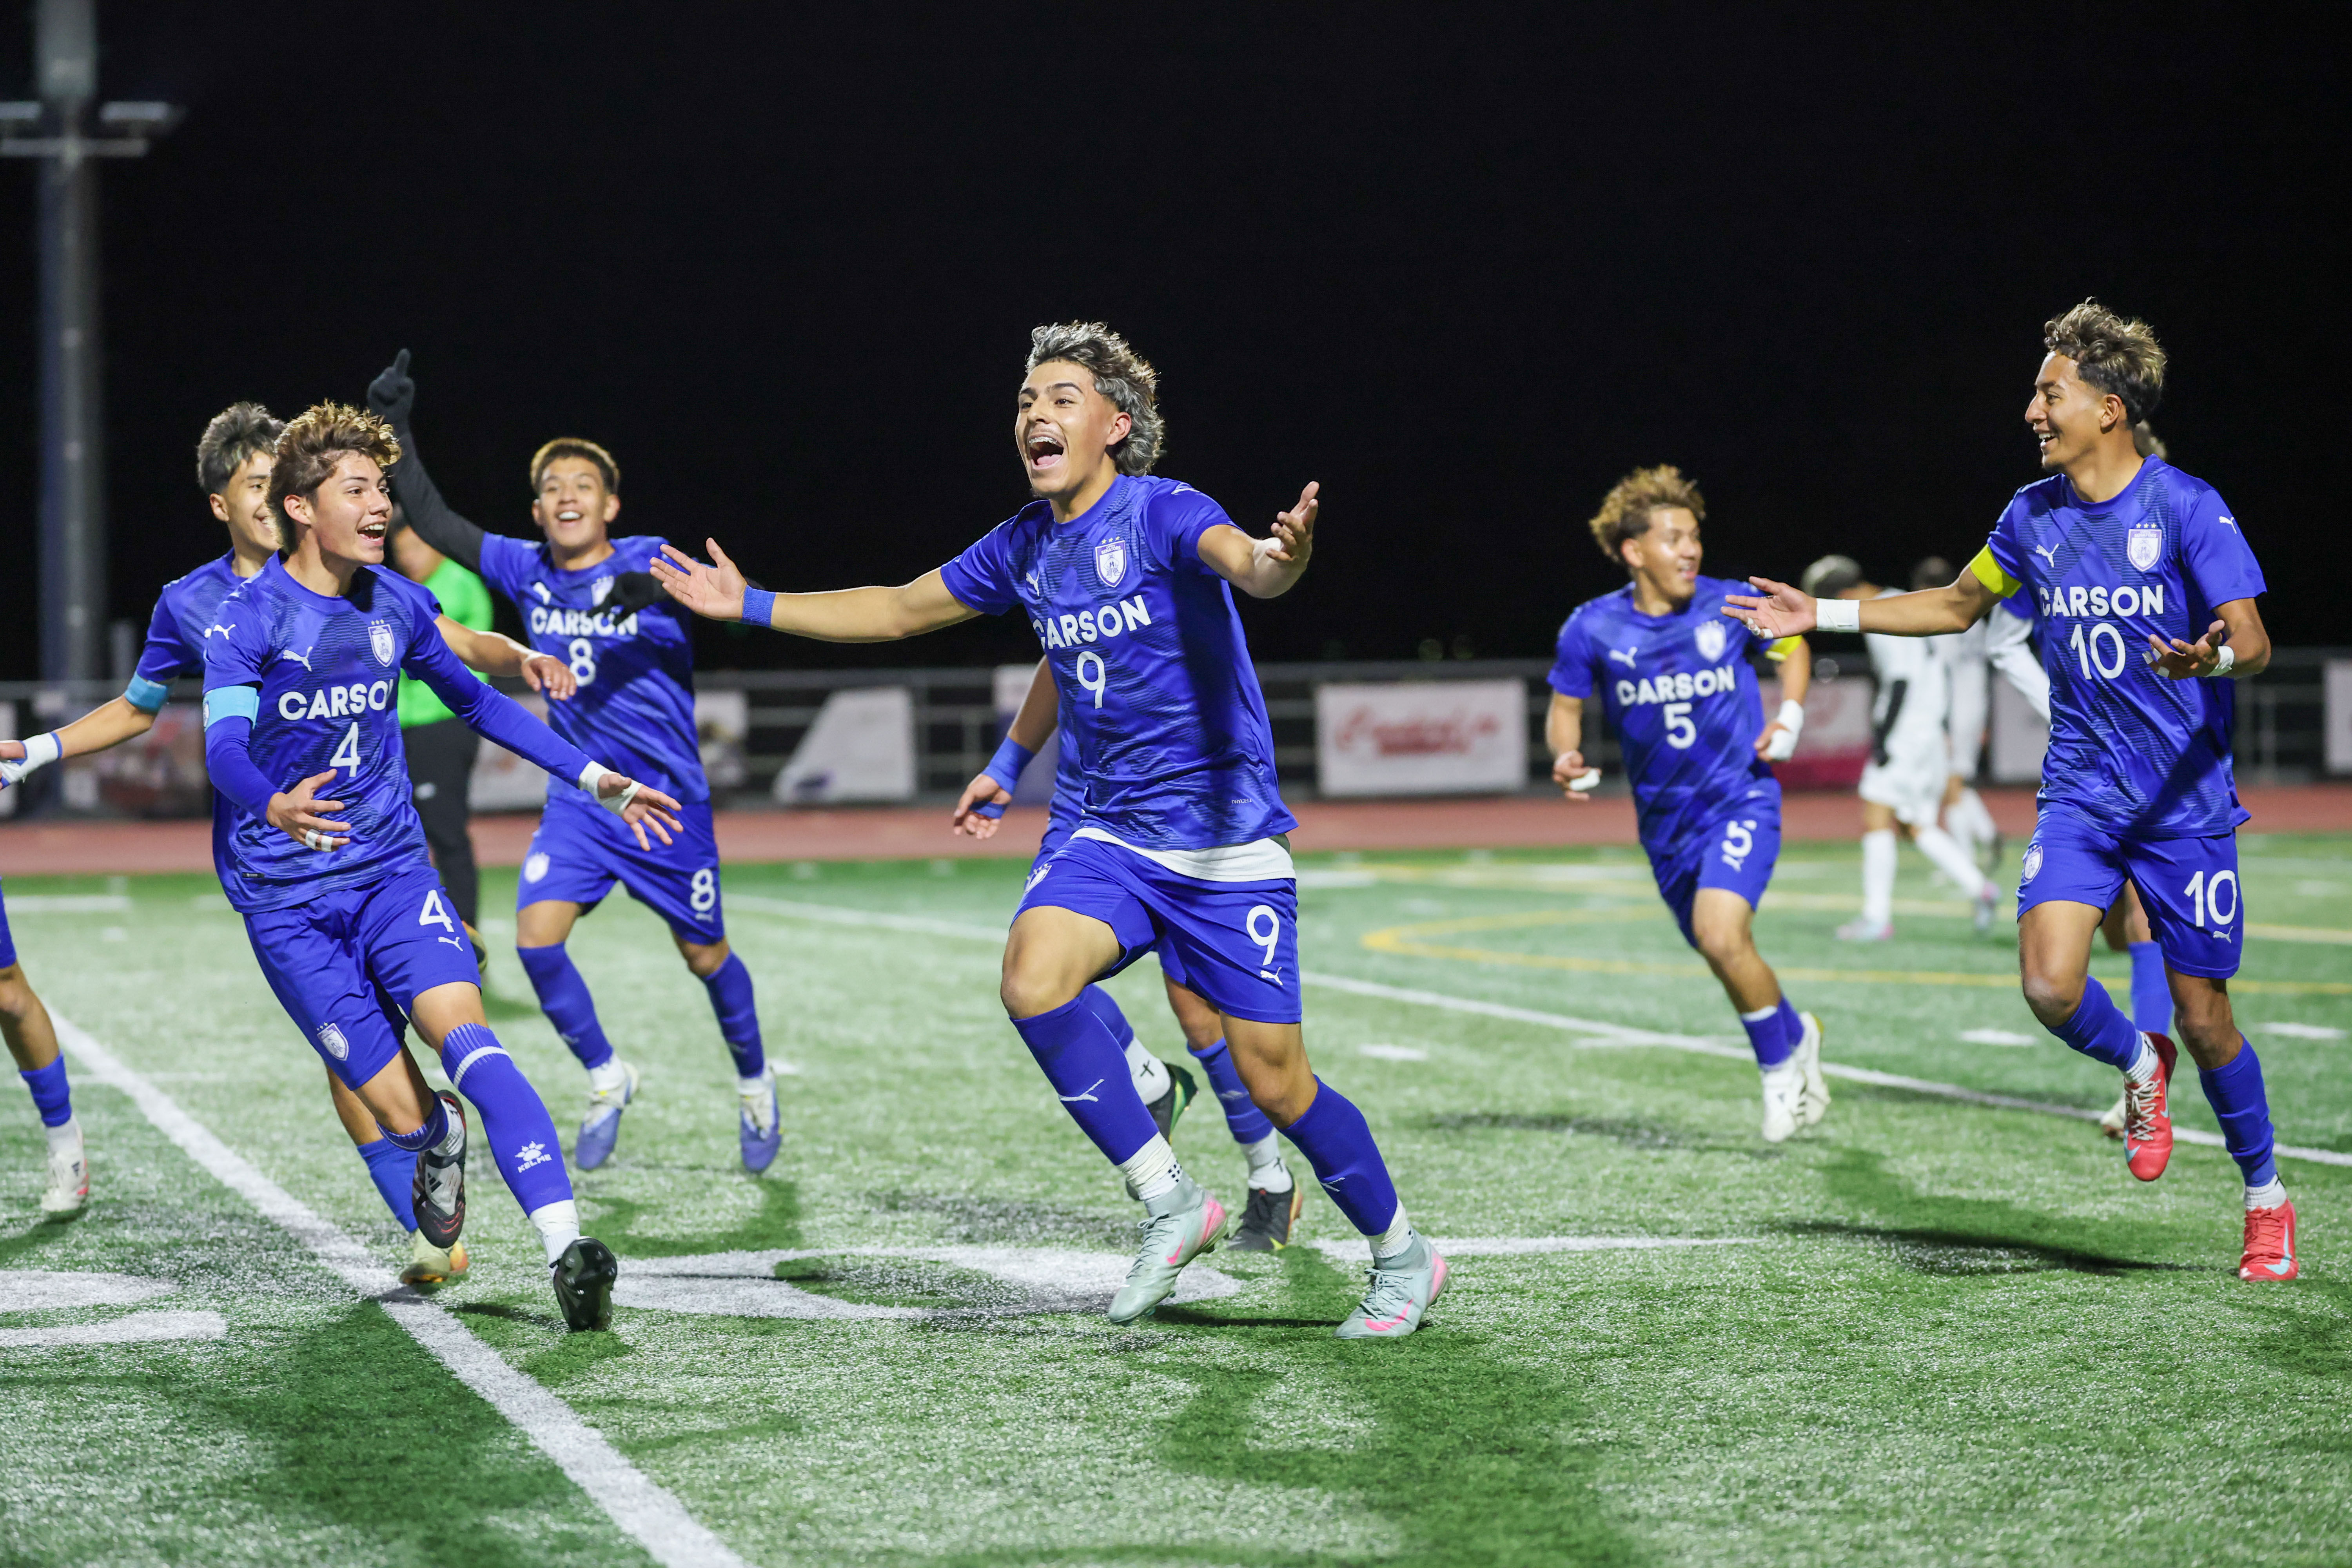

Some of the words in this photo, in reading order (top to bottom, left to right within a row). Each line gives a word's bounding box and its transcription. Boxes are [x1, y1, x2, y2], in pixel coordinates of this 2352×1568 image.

[531, 606, 638, 637] CARSON
[2040, 584, 2163, 617] CARSON
[569, 638, 596, 686] 8
[2070, 622, 2126, 680] 10
[1076, 651, 1106, 709] 9
[1616, 665, 1736, 706] CARSON
[1663, 702, 1697, 750] 5
[329, 722, 361, 777] 4
[1721, 820, 1757, 858] 5
[418, 889, 452, 933] 4
[690, 868, 716, 911] 8
[2184, 870, 2237, 927] 10
[1246, 905, 1279, 966] 9
[517, 1154, 552, 1173] KELME
